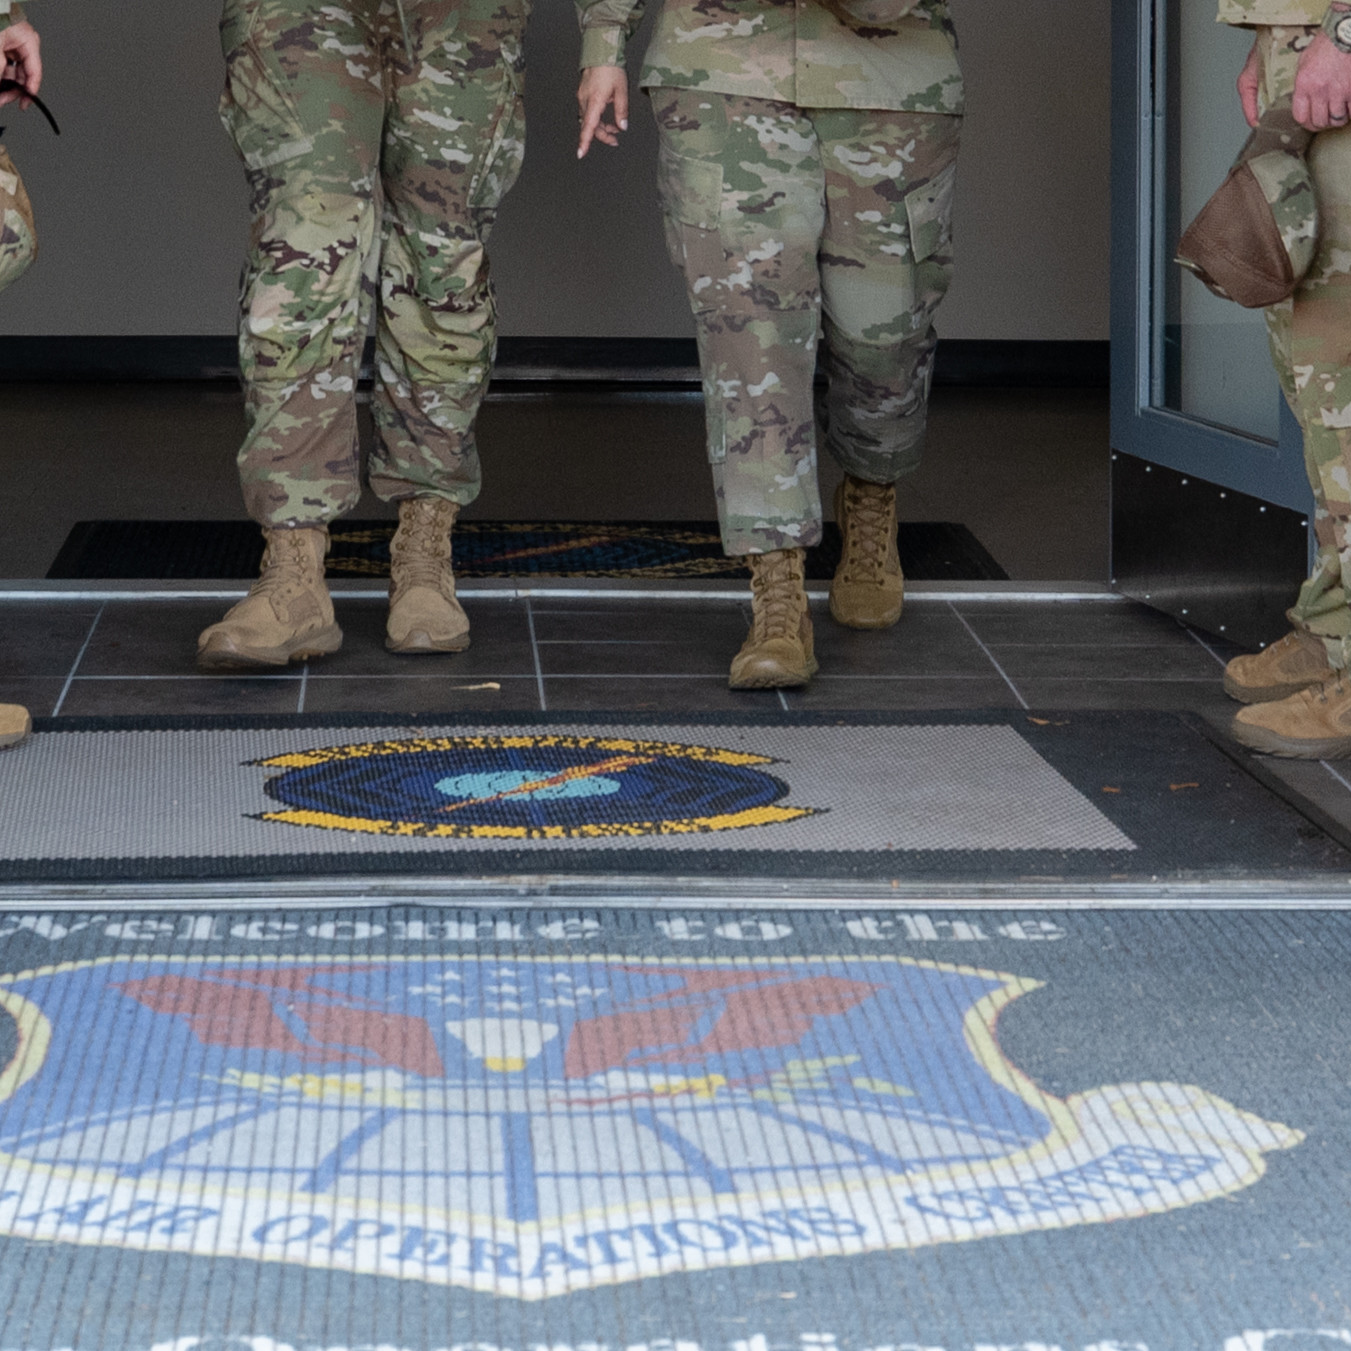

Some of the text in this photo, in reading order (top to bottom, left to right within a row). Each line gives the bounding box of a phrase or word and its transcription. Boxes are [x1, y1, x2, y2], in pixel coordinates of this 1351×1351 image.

[654, 916, 792, 941] to
[842, 913, 1067, 941] the
[17, 1192, 217, 1236] AIR
[250, 1205, 867, 1280] OPERATIONS
